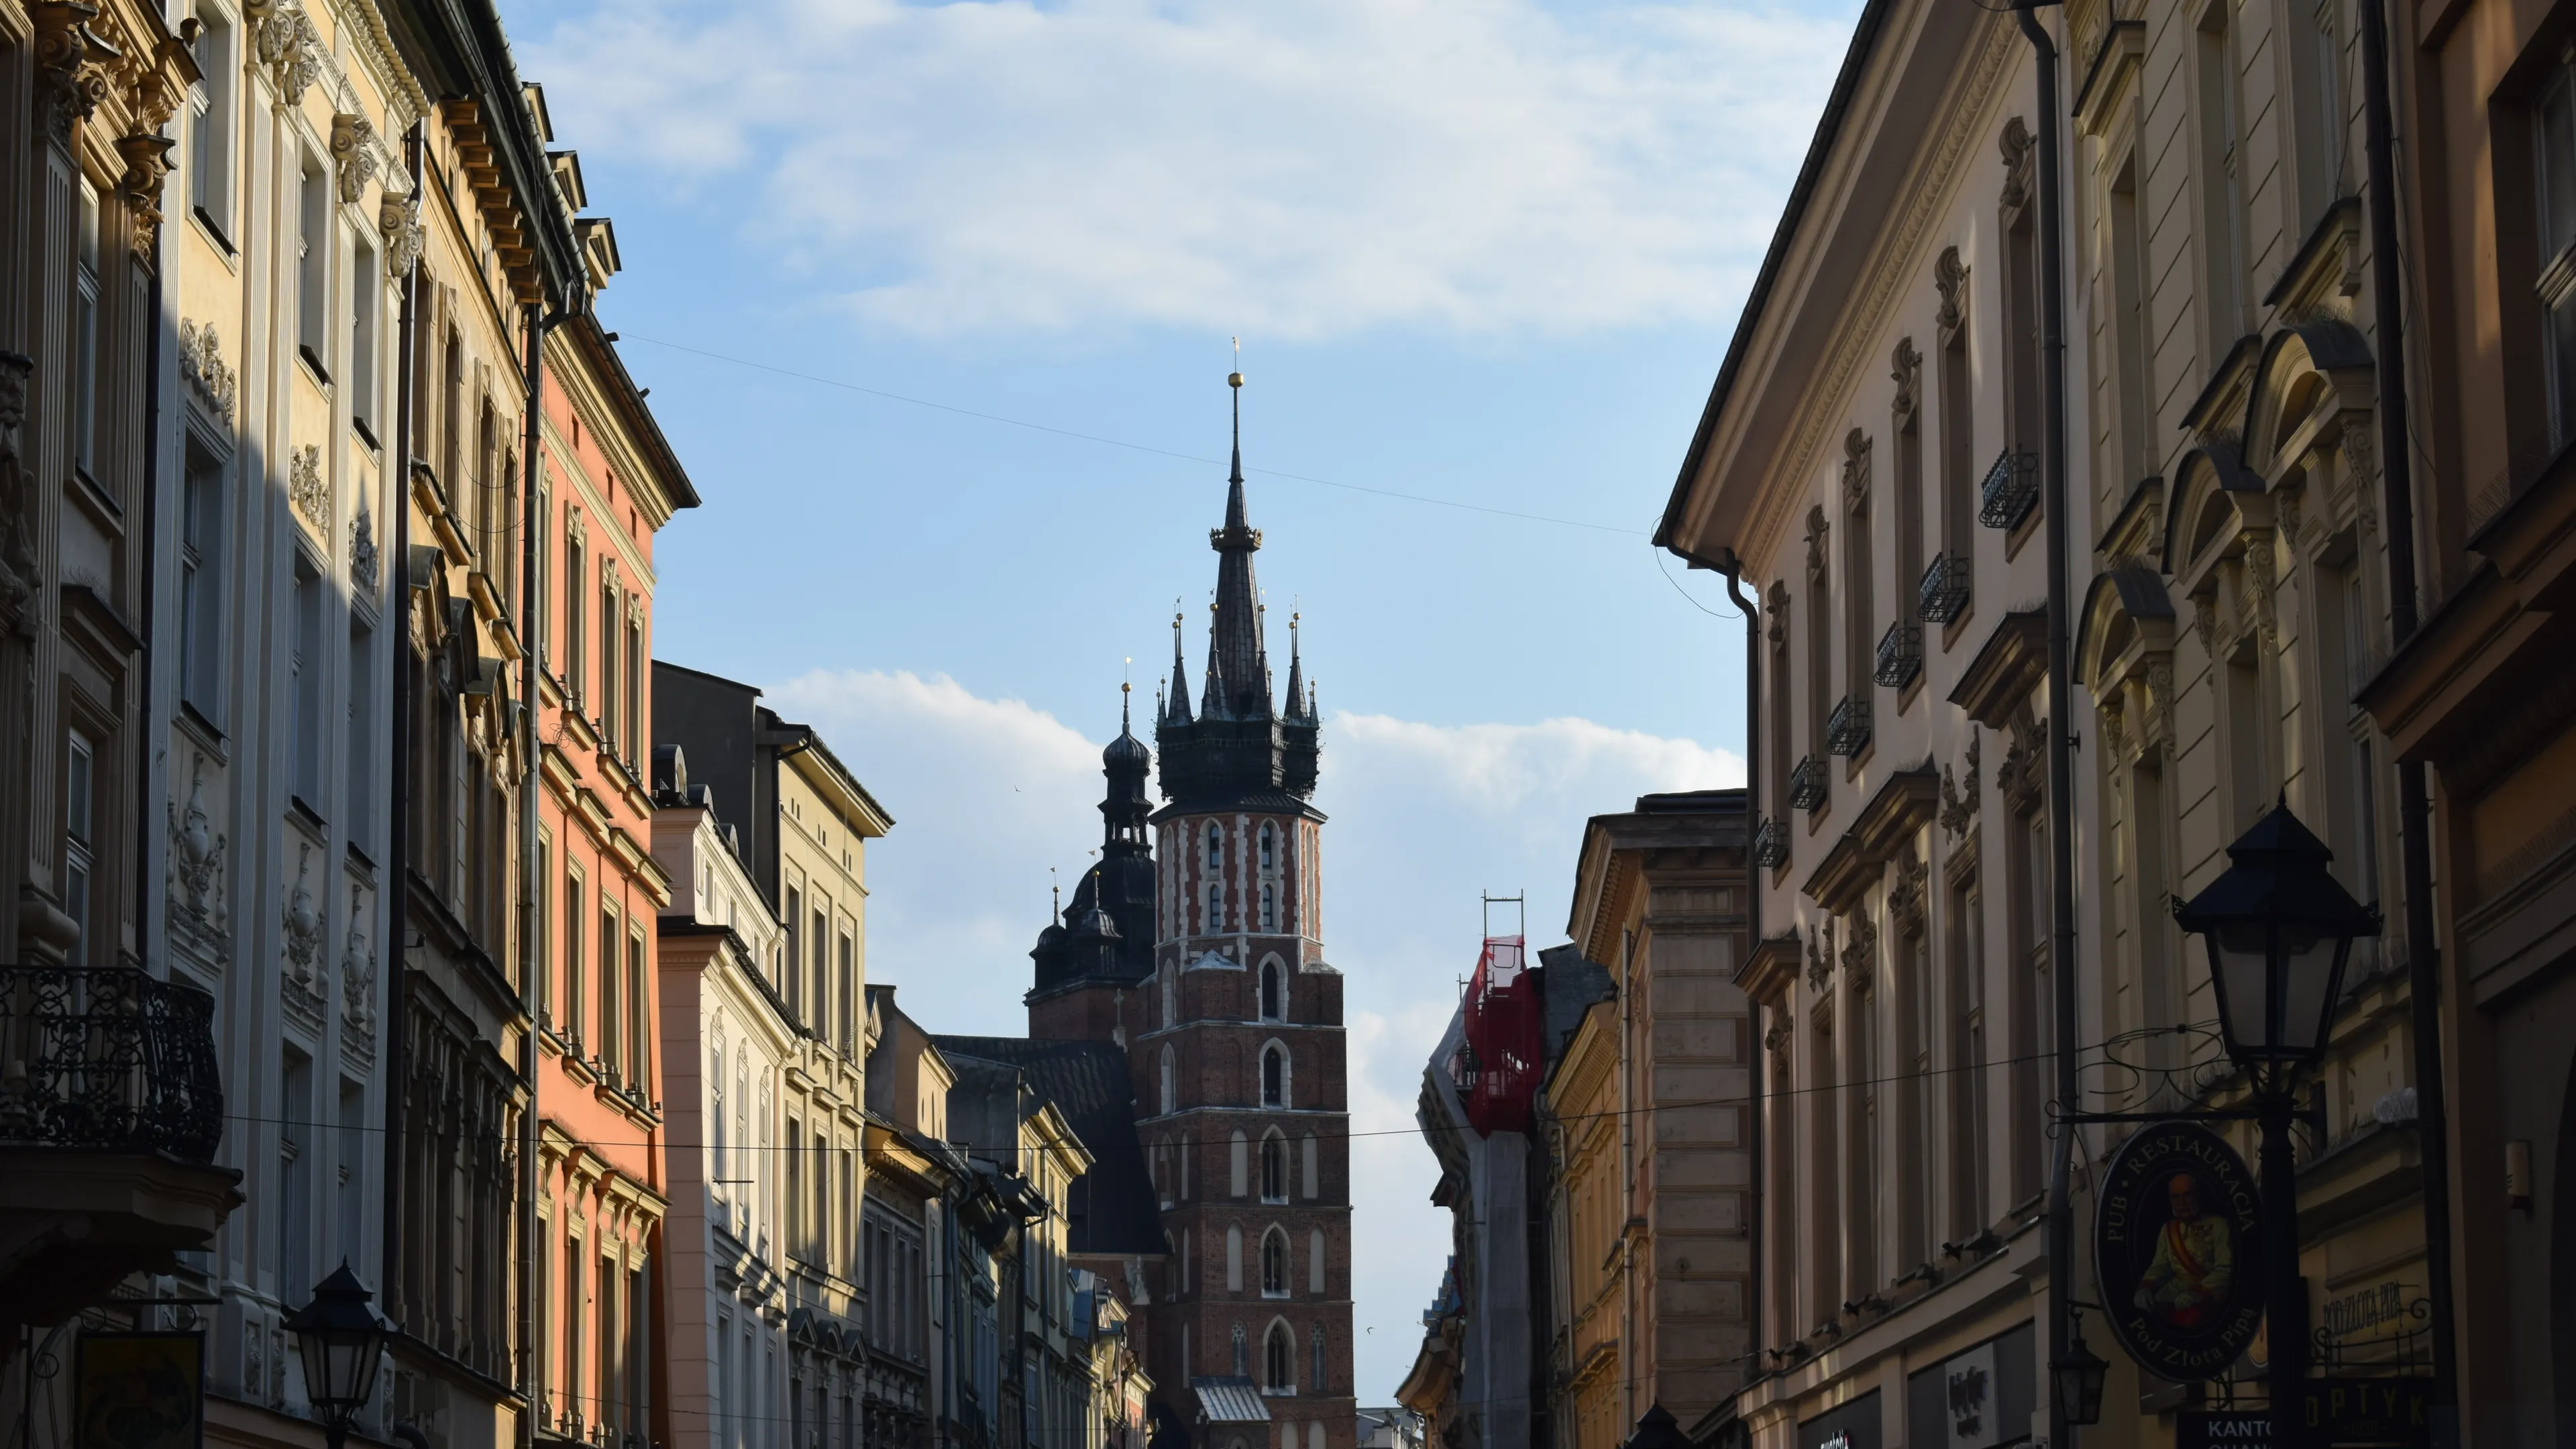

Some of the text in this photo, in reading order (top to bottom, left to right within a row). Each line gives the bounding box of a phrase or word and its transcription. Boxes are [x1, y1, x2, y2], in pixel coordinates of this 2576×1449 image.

[2108, 1135, 2255, 1242] PUB RESTAURACJA
[2129, 1316, 2162, 1353] Pod
[2305, 1383, 2424, 1427] OPTYK
